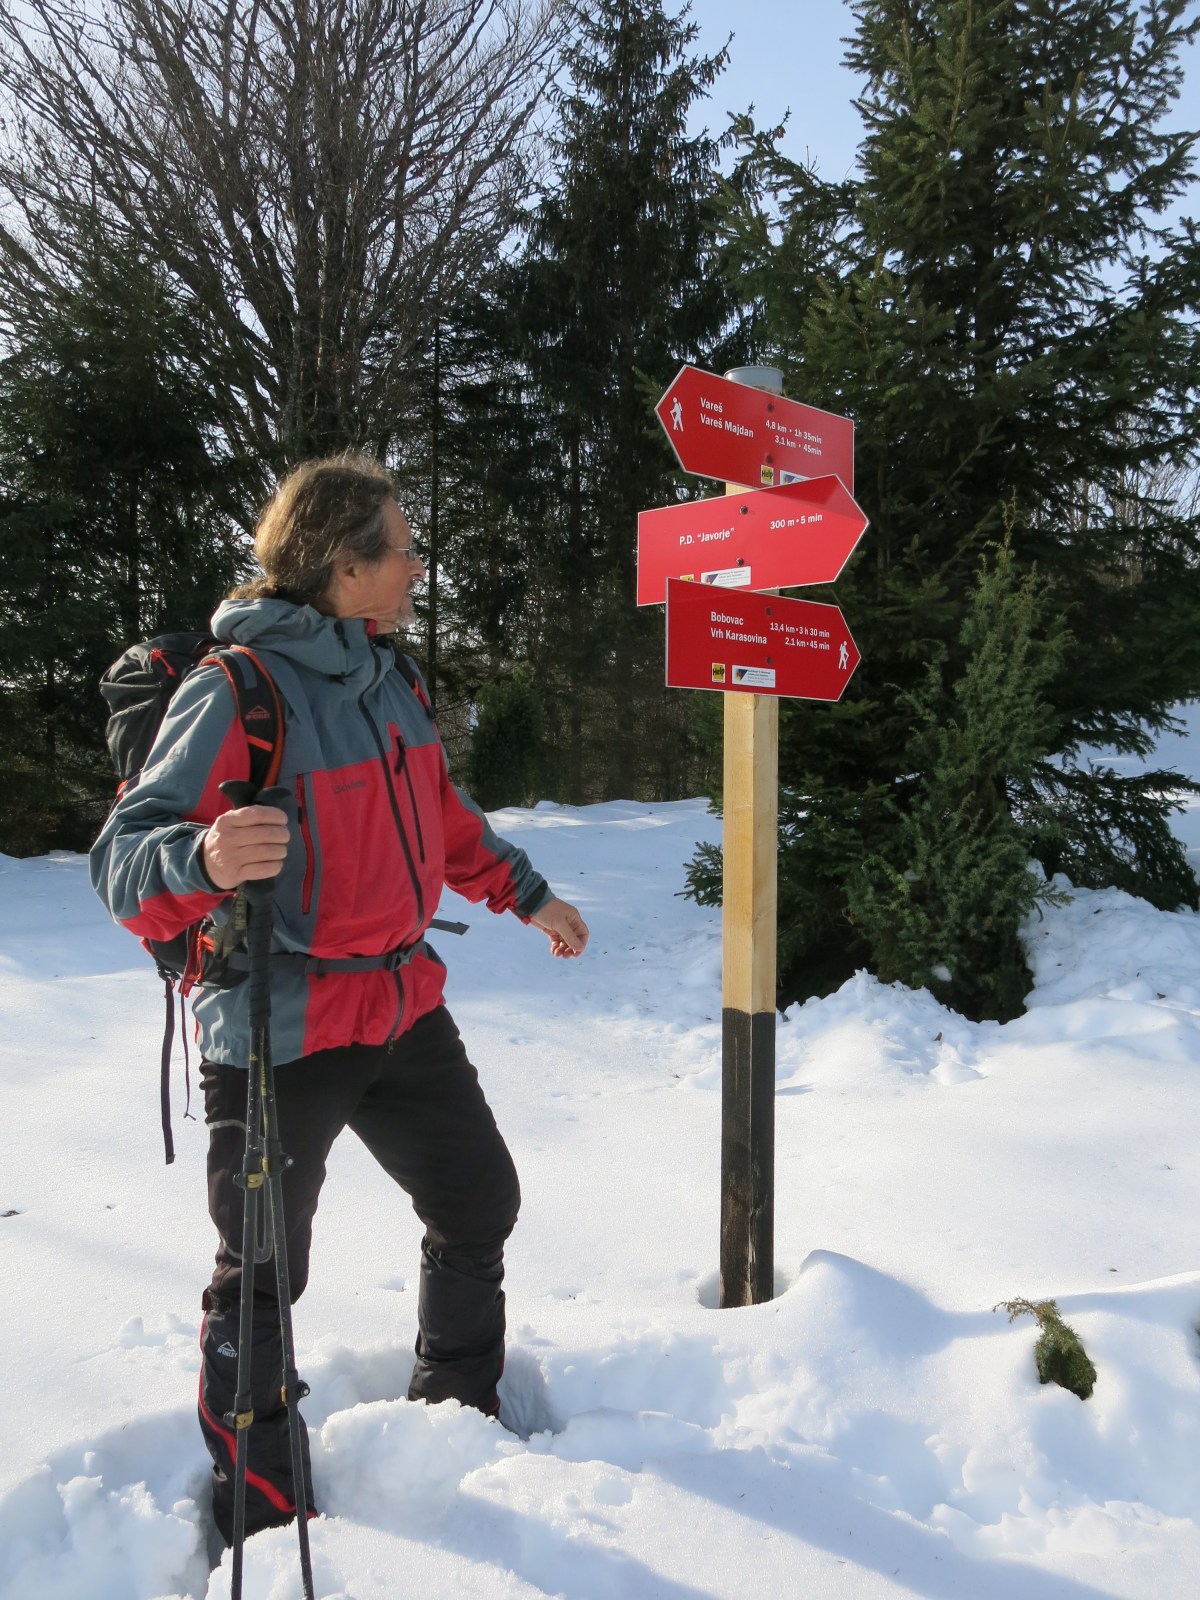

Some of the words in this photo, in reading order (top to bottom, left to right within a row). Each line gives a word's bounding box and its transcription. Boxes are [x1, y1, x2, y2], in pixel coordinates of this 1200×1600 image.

[700, 397, 723, 413] Vareš
[700, 413, 723, 429] Vareš
[724, 420, 754, 438] Majdan
[765, 419, 776, 430] 4,8
[777, 422, 787, 433] km
[774, 435, 786, 445] 3,1
[786, 438, 796, 448] km
[803, 444, 822, 456] 45min
[761, 469, 774, 481] Help
[770, 519, 785, 530] 300
[807, 513, 823, 523] min
[679, 534, 695, 545] P.D.
[711, 611, 744, 626] Bobovac
[710, 627, 724, 639] Vrh
[725, 630, 767, 645] Karasovina
[770, 622, 784, 632] 13,4
[810, 627, 818, 637] 30
[819, 629, 830, 638] min
[785, 637, 795, 647] 2,1
[819, 641, 830, 650] min
[712, 666, 725, 677] Help
